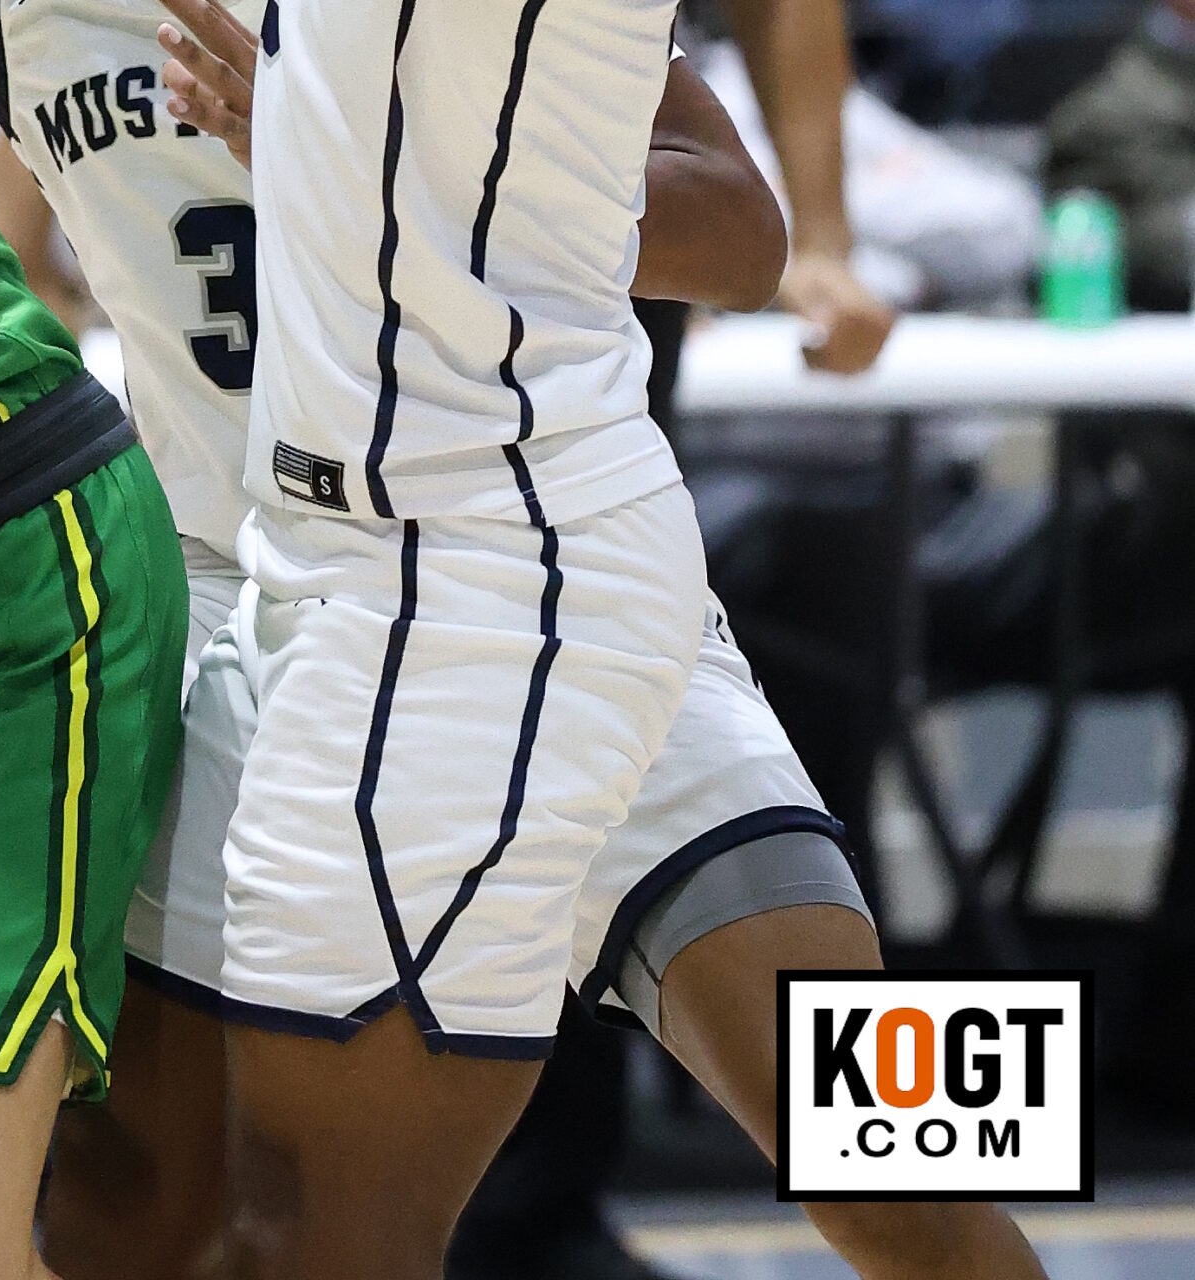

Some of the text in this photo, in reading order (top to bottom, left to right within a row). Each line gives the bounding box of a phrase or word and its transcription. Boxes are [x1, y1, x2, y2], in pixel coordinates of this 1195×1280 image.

[34, 66, 199, 174] MUS
[168, 197, 259, 397] 3
[319, 475, 332, 496] S
